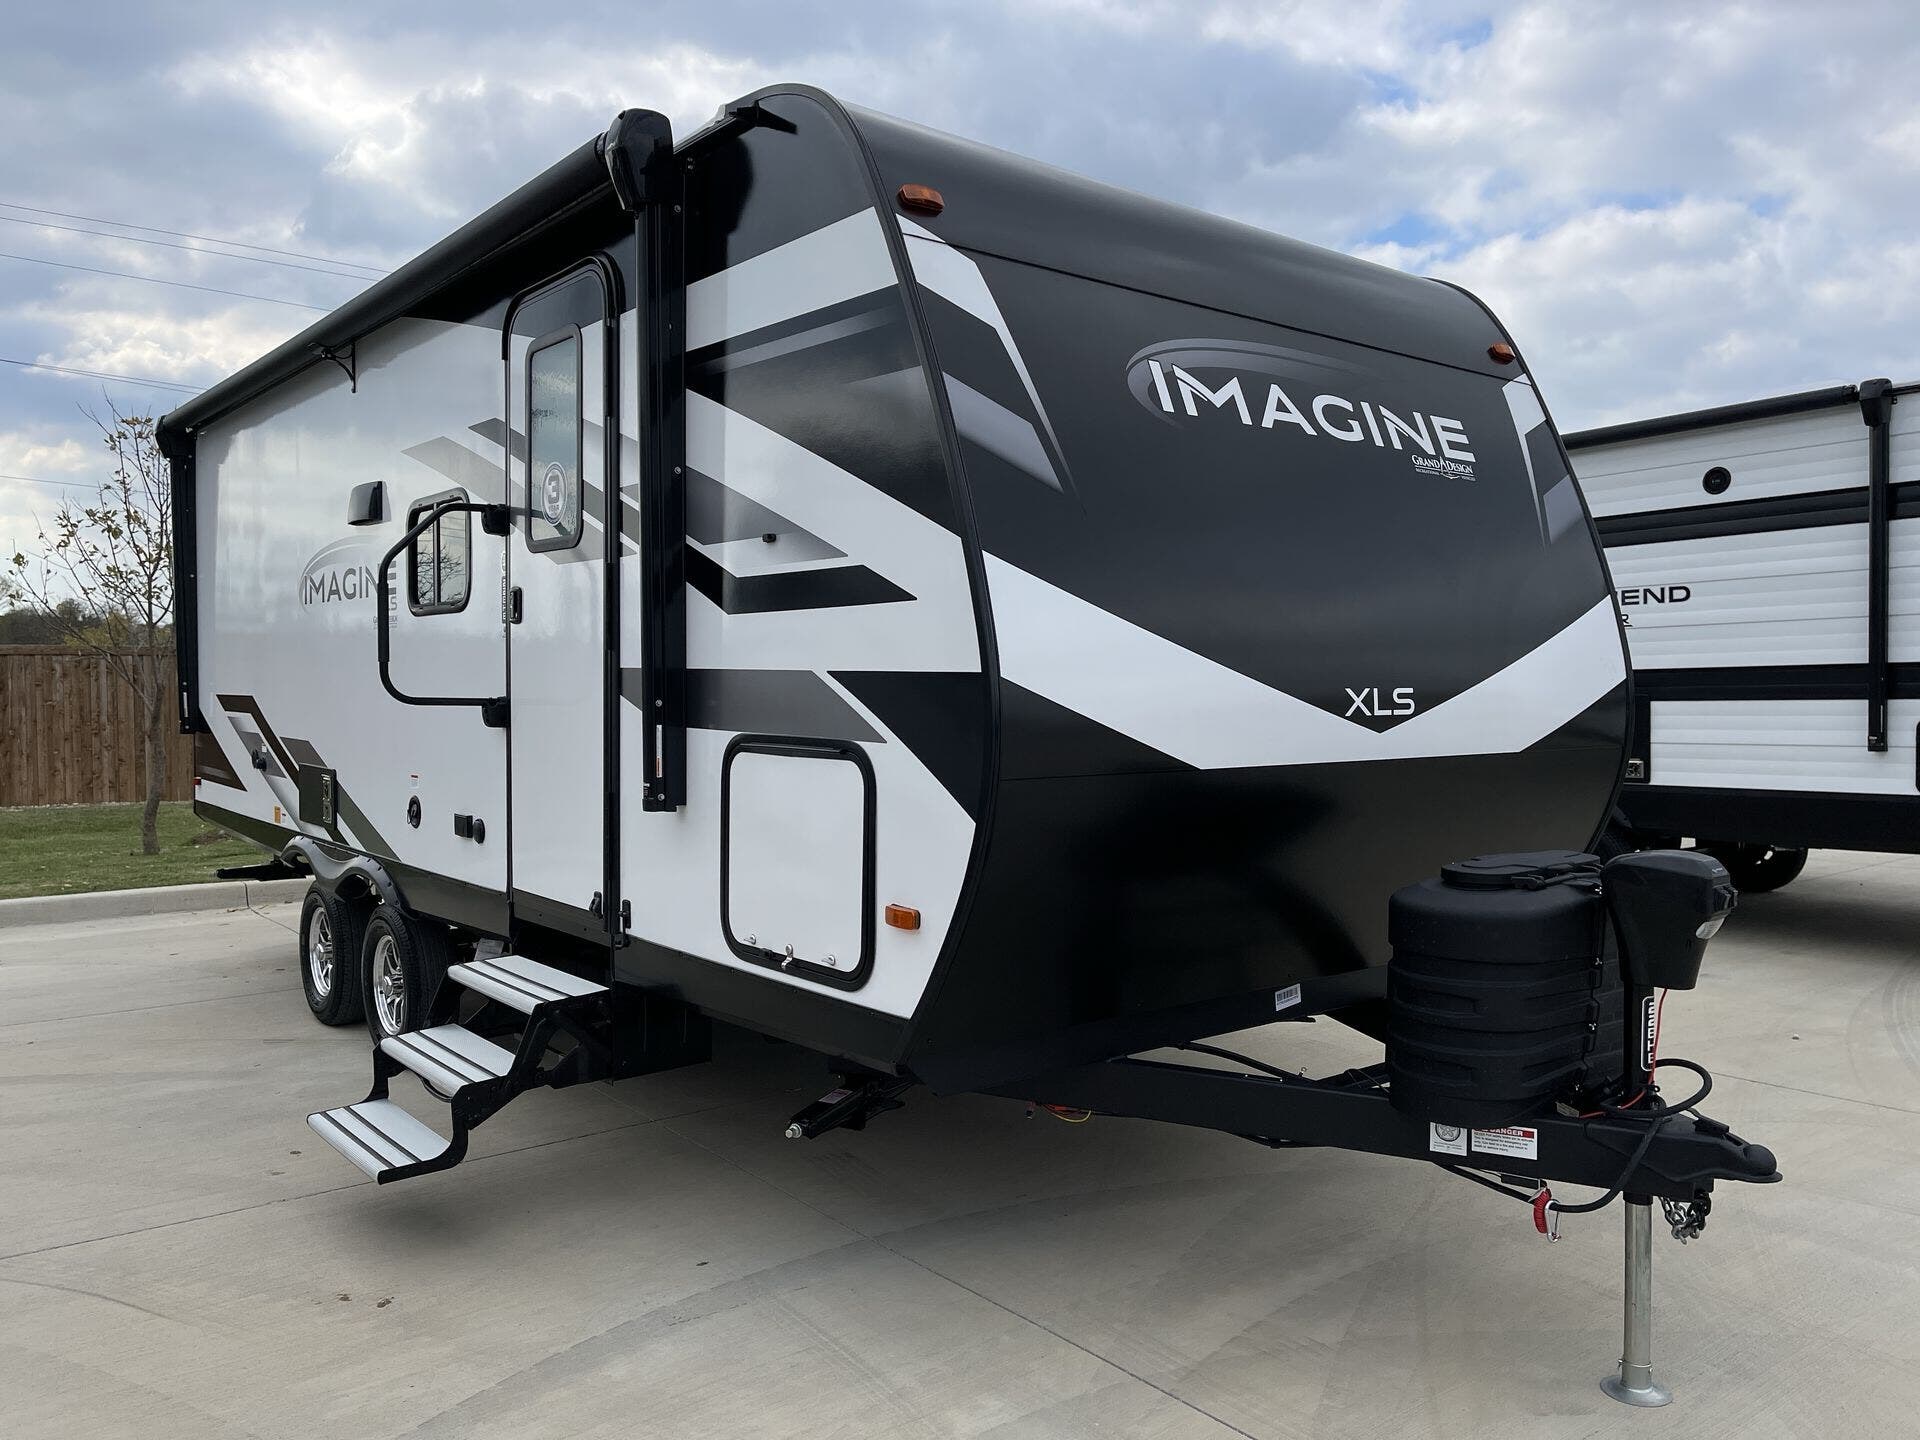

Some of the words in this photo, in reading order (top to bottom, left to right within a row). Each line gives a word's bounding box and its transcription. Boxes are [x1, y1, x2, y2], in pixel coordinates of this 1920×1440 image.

[1148, 359, 1476, 462] IMAGINE
[1411, 454, 1440, 469] GRAND
[1446, 460, 1474, 474] DESIGN
[304, 560, 397, 605] IMAGINE
[1615, 585, 1691, 606] END
[1344, 687, 1416, 717] XLS
